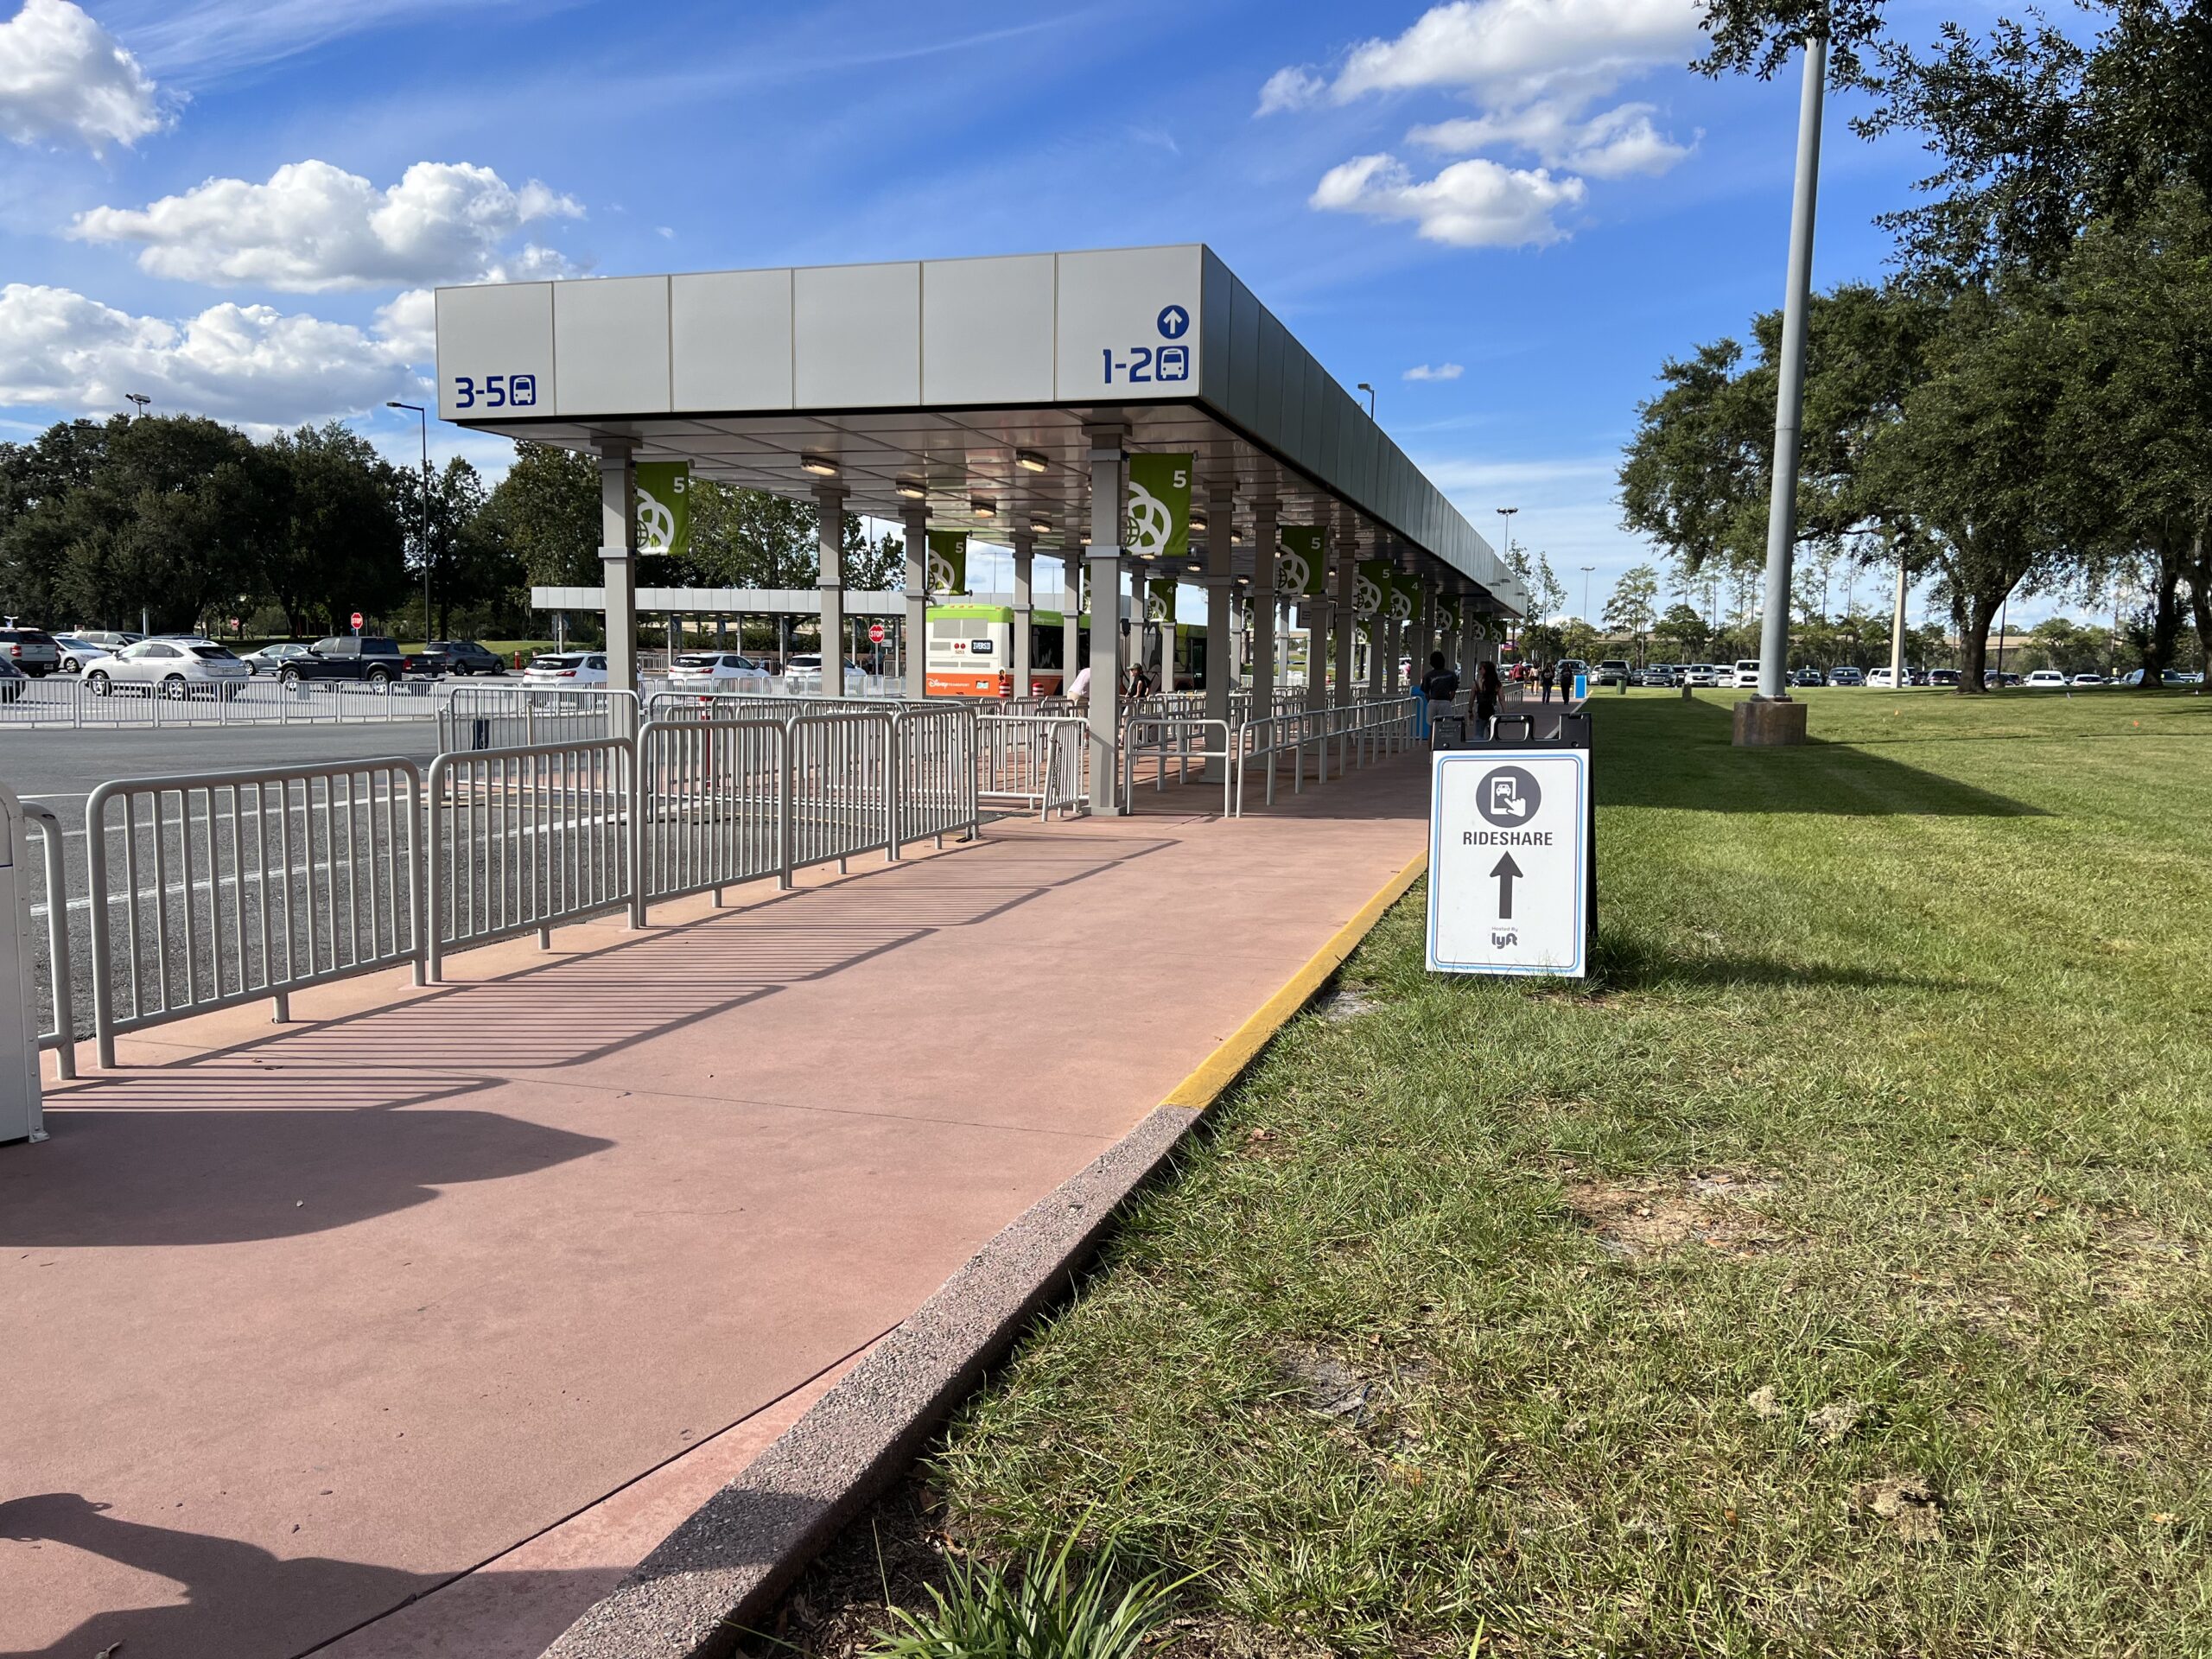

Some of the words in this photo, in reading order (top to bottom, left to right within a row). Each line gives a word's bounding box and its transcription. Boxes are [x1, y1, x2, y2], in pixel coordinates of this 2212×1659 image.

[1103, 346, 1153, 384] 1-2
[454, 375, 506, 409] 3-5
[673, 476, 685, 494] 5
[1173, 470, 1187, 489] 5
[955, 542, 964, 554] 5
[1311, 537, 1321, 550] 5
[1382, 569, 1390, 579] 5
[1166, 586, 1174, 594] 4
[1411, 582, 1419, 591] 4
[1462, 831, 1554, 846] RIDESHARE
[1491, 932, 1518, 950] lyft
